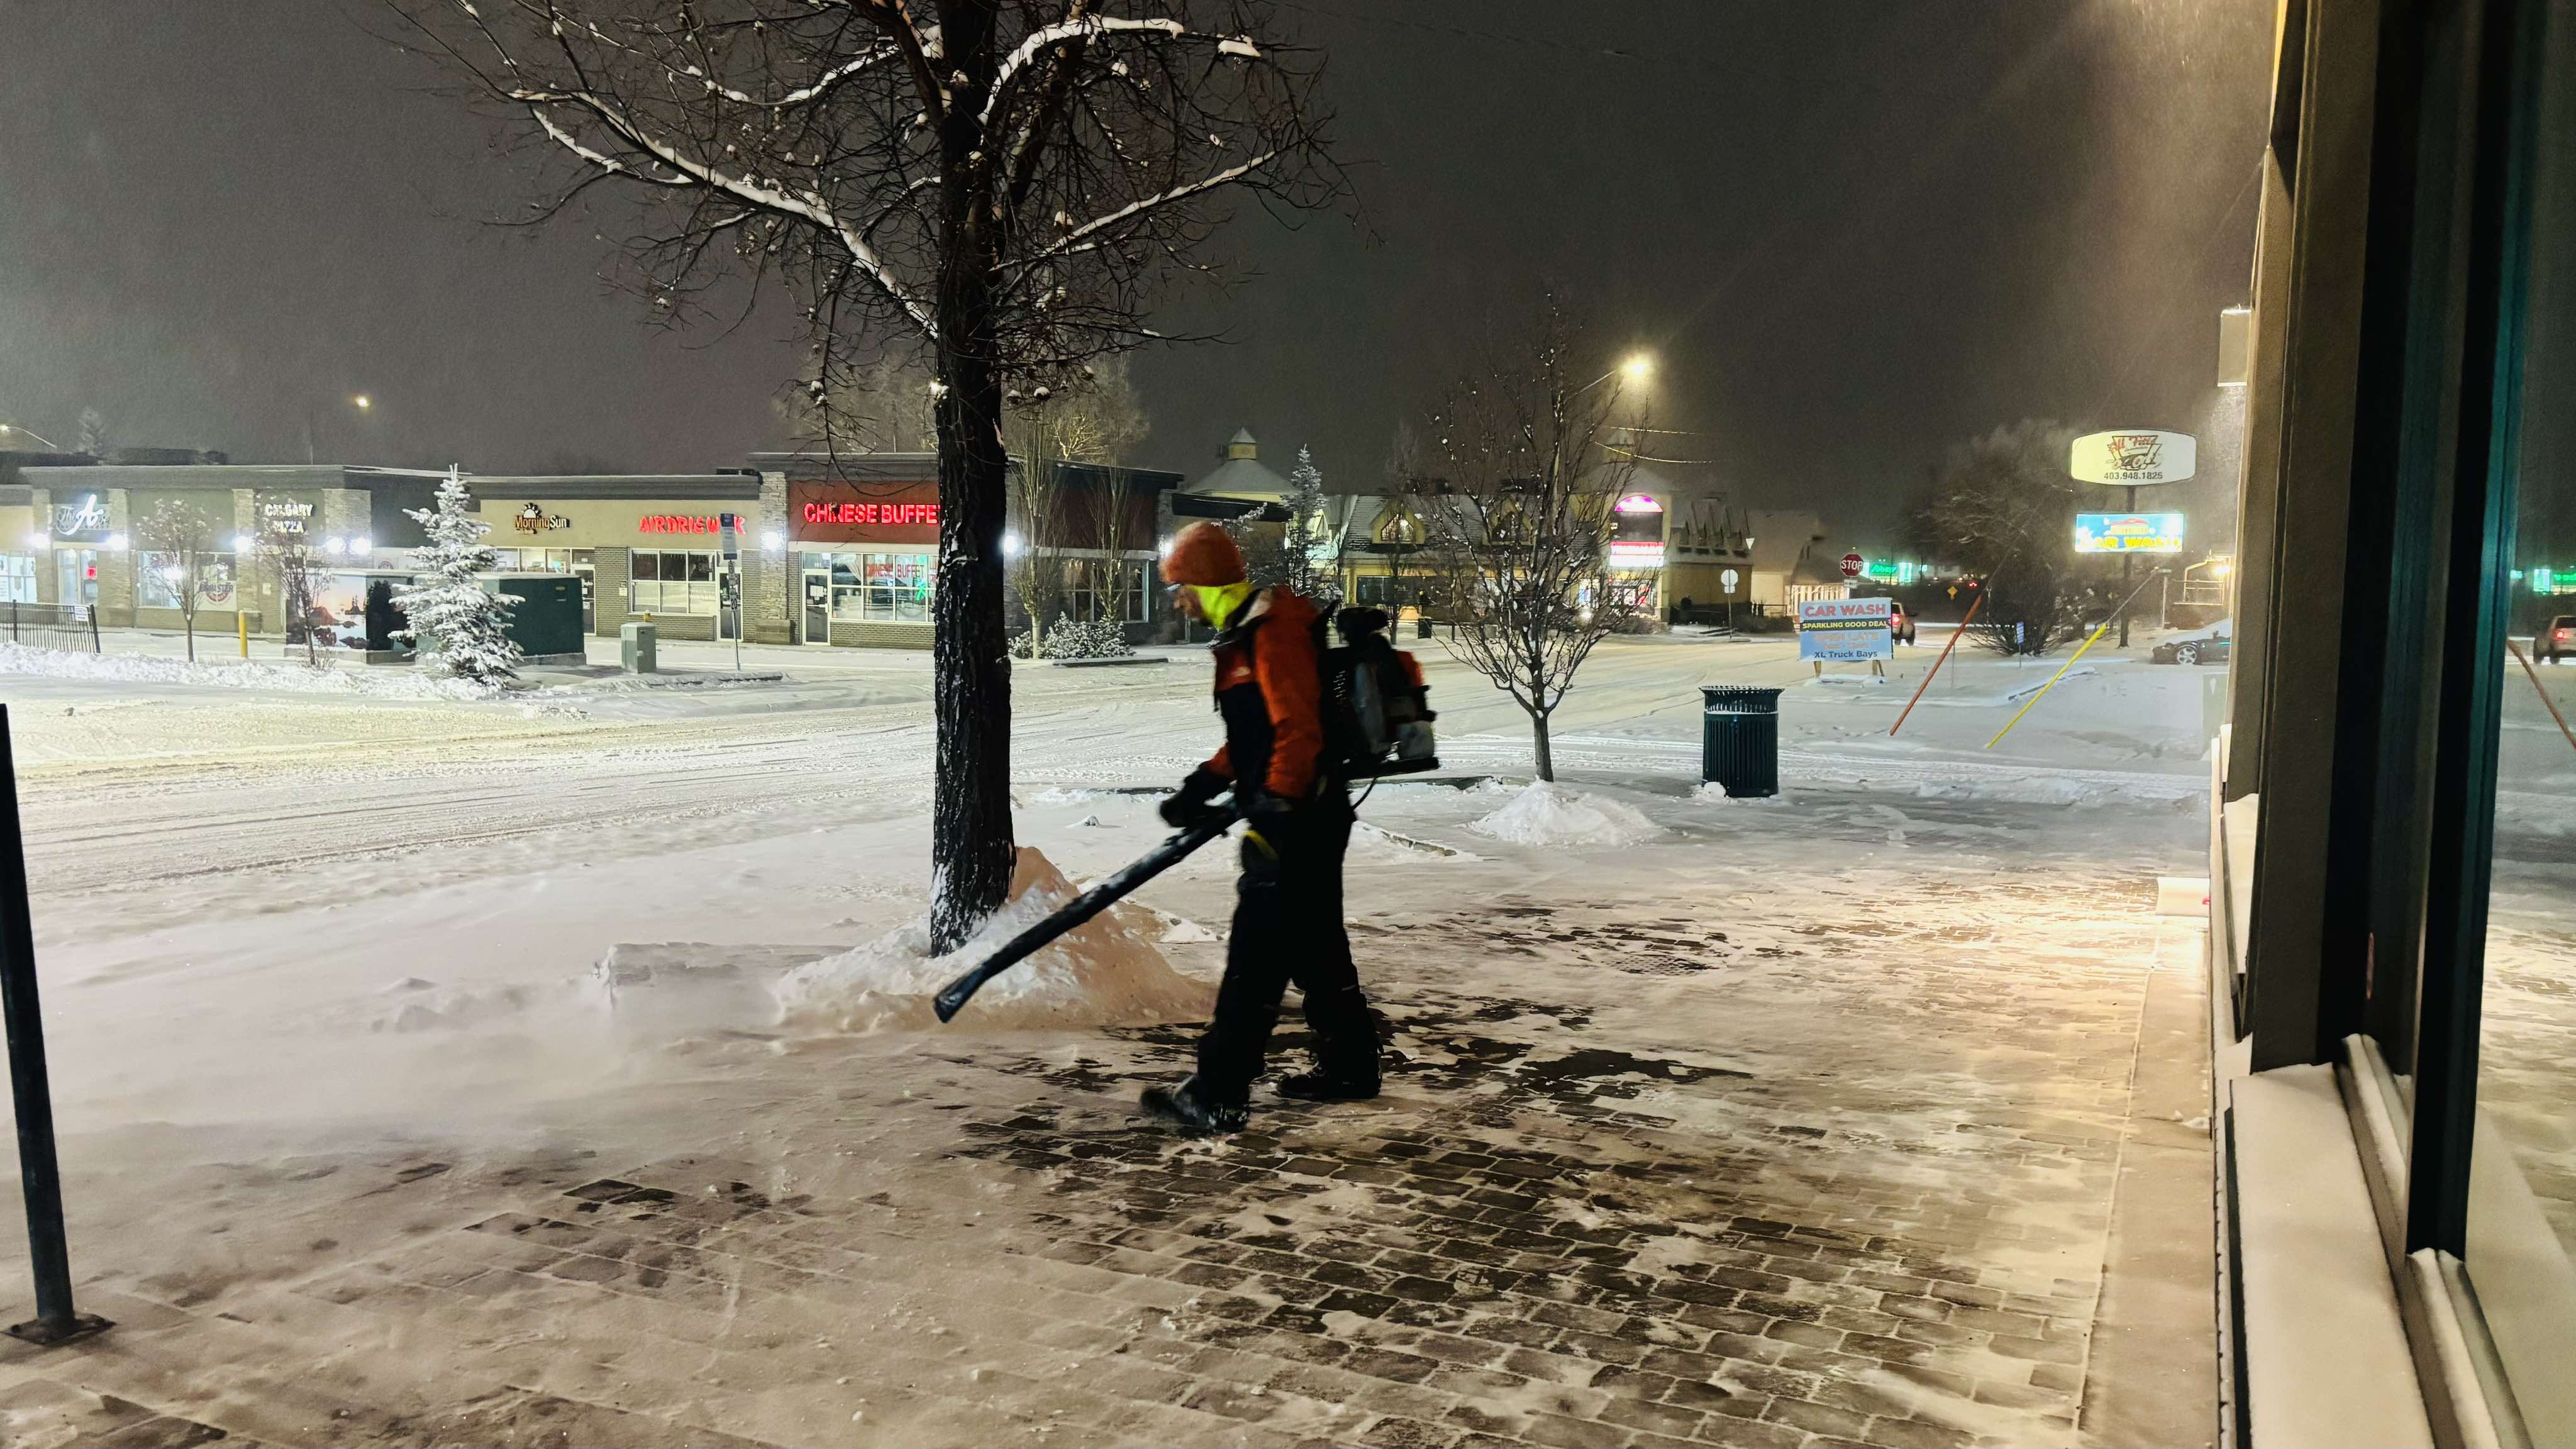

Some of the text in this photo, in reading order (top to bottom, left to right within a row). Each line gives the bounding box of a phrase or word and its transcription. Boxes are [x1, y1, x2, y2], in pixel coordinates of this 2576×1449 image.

[265, 504, 313, 516] CALGARY
[881, 504, 941, 524] BUFFE
[639, 516, 704, 534] AIRDRIE
[706, 516, 746, 534] WK
[897, 564, 924, 577] BUFFET
[1841, 560, 1863, 570] STOP
[1805, 604, 1886, 617] CAR WASH
